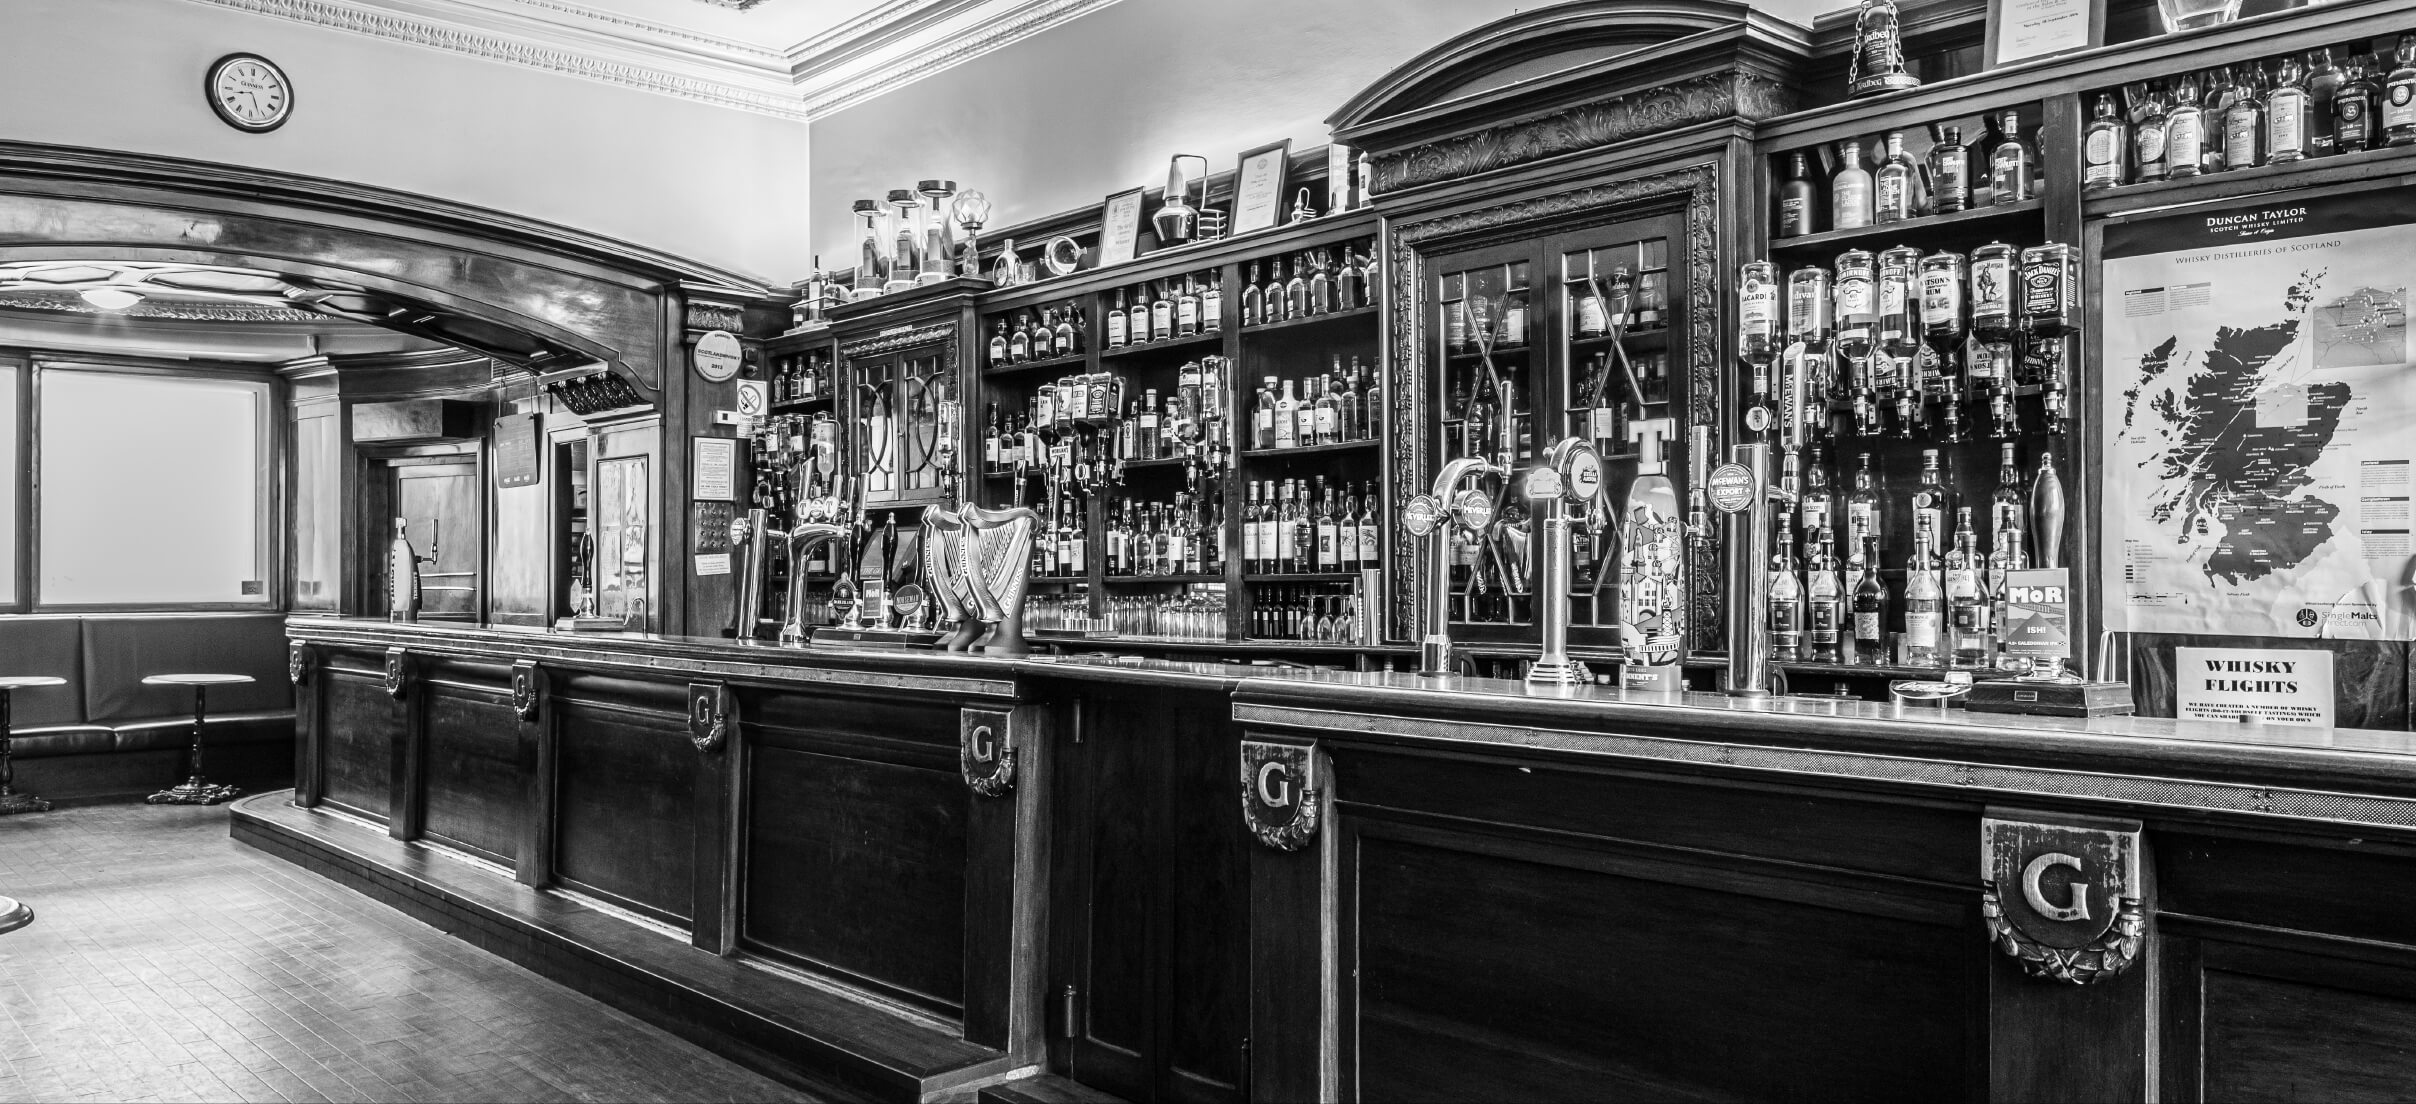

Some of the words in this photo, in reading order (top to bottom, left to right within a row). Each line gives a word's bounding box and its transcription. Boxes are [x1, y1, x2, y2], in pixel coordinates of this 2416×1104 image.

[240, 80, 264, 91] GUINNESS
[2206, 213, 2258, 227] DUNCAN
[2262, 207, 2307, 220] TAYLOR
[2210, 225, 2239, 233] SCOTCH
[2242, 221, 2270, 230] WHISKY
[2273, 217, 2304, 226] LIMITED
[2175, 254, 2211, 264] WHISKY
[2214, 249, 2272, 261] DISTILLERIES
[2291, 240, 2341, 252] SCOTLAND
[2025, 265, 2040, 281] JACK
[2039, 263, 2061, 277] DANIEL'S
[1926, 288, 1941, 296] RUM
[1628, 417, 1676, 476] T
[1712, 476, 1749, 486] McEWAN'S
[1717, 488, 1744, 496] EXPORT
[1004, 566, 1024, 610] GUINNESS
[2027, 626, 2046, 634] ISH!
[388, 659, 396, 680] G
[2205, 660, 2296, 674] WHISKY
[516, 674, 526, 698] G
[2205, 679, 2298, 694] FLIGHTS
[696, 696, 710, 725] G
[972, 724, 993, 762] G
[1256, 762, 1289, 807] G
[2021, 852, 2091, 923] G
